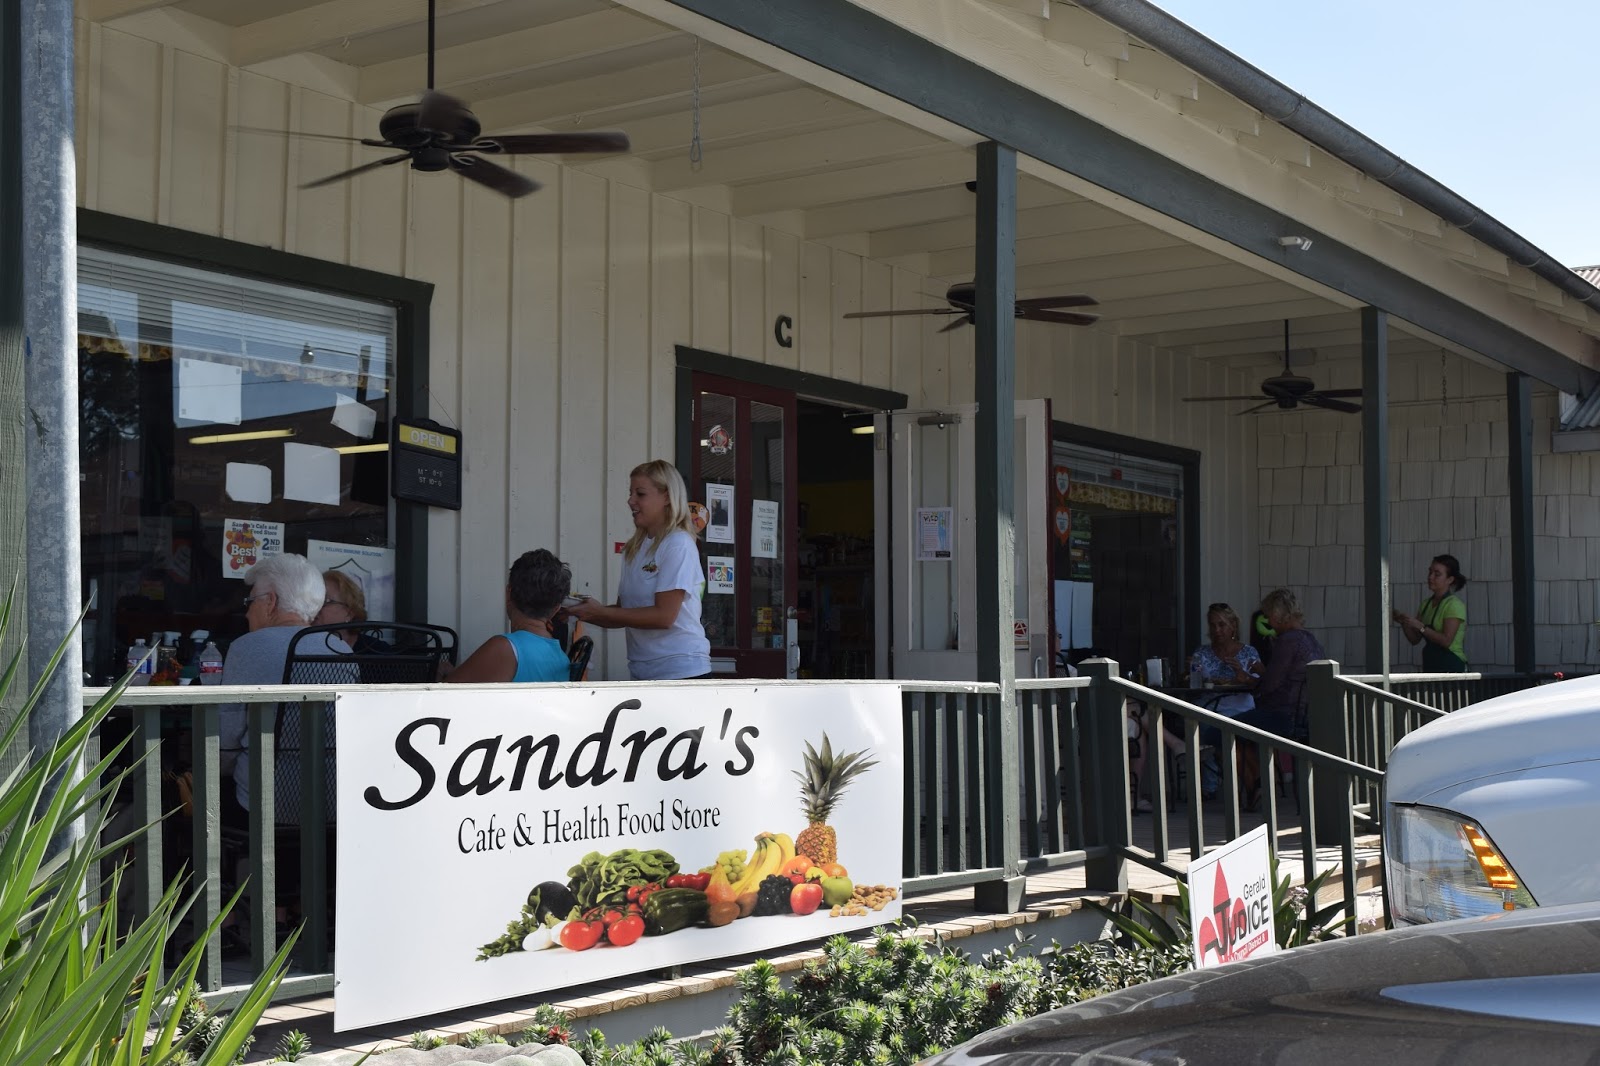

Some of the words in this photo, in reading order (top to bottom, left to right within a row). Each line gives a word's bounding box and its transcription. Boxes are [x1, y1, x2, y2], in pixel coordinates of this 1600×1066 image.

[774, 314, 793, 349] C
[410, 429, 445, 449] OPEN
[230, 544, 256, 557] Best
[363, 698, 761, 811] Sandra's
[457, 813, 506, 855] Cafe
[512, 812, 536, 848] &
[542, 803, 610, 845] Health
[616, 798, 666, 837] Food
[671, 797, 722, 832] Store
[1243, 873, 1266, 901] Gerald
[1205, 894, 1270, 956] JUDICE
[1248, 936, 1262, 952] District
